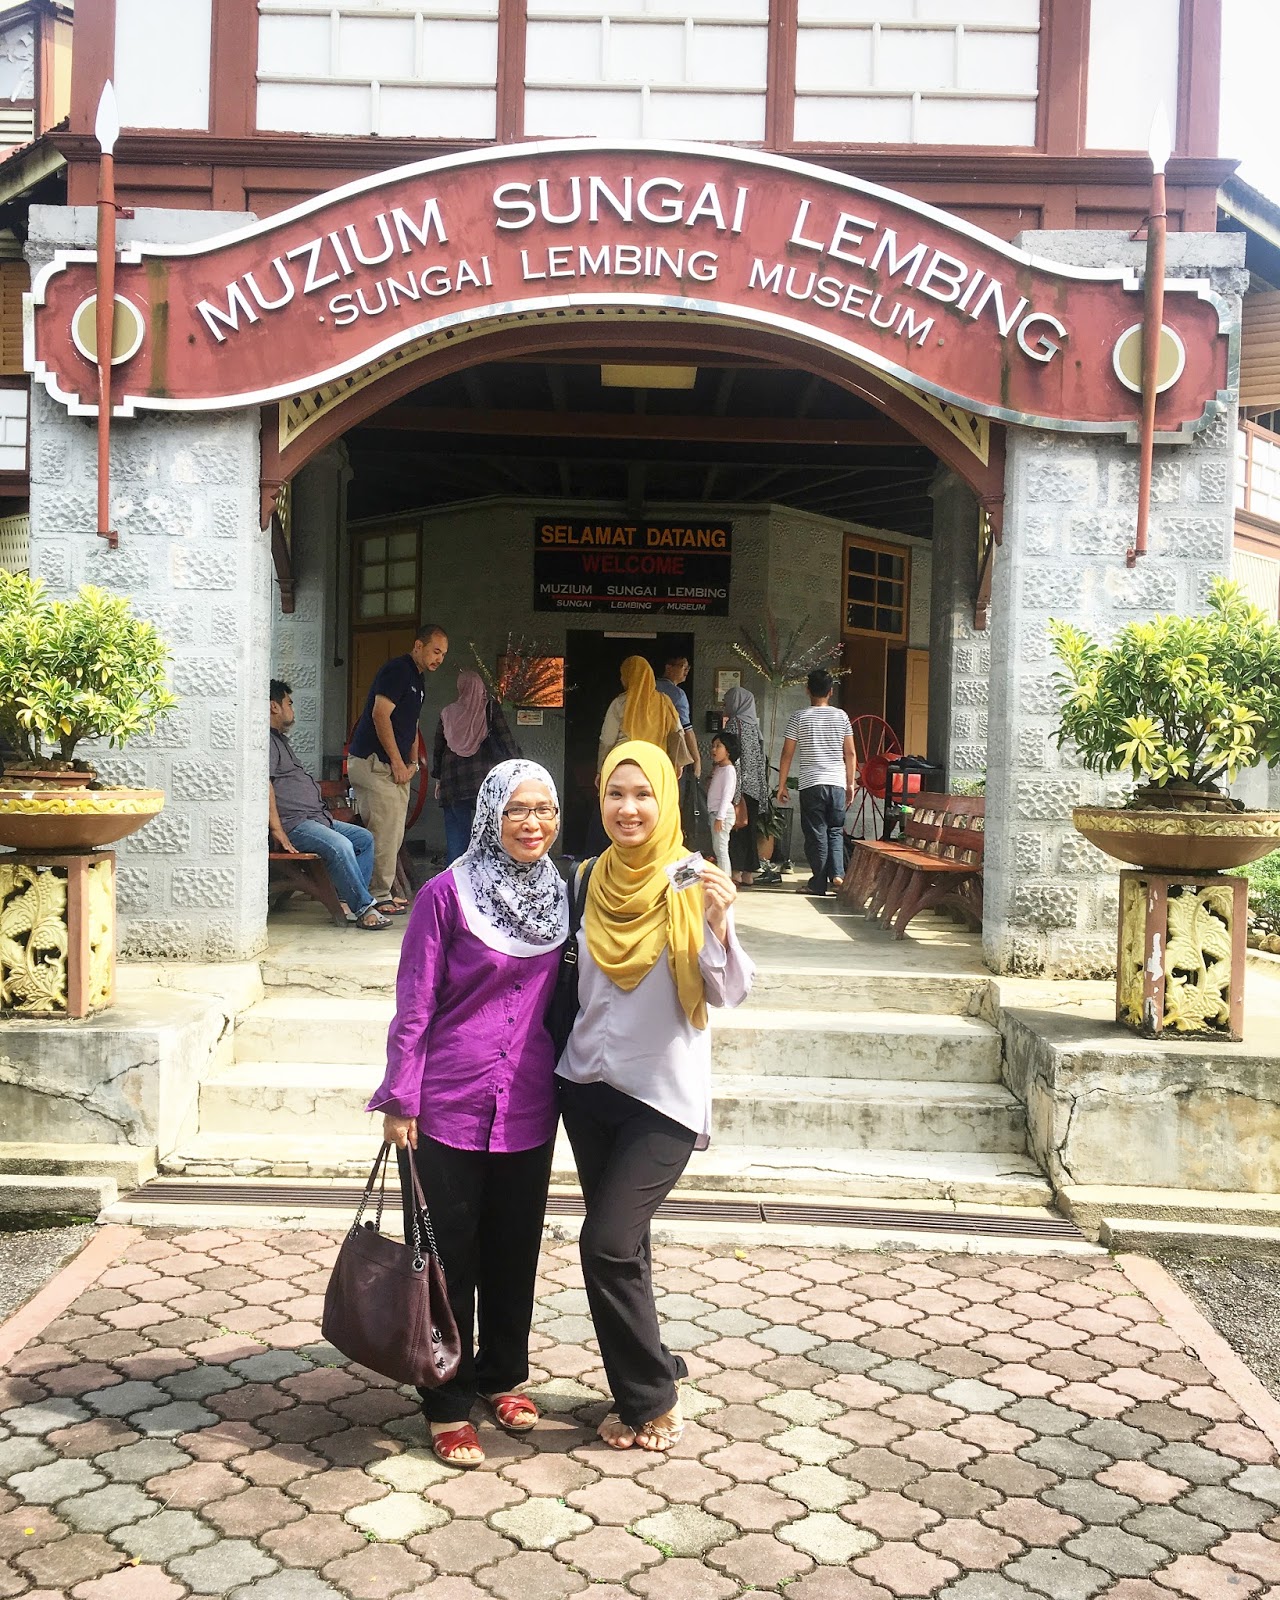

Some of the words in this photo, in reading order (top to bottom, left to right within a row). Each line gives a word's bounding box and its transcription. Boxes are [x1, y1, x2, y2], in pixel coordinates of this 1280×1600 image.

[195, 197, 449, 345] MUZIUM
[492, 175, 751, 233] SUNGAI
[788, 198, 1069, 363] LEMBING
[328, 255, 493, 326] SUNGAI
[519, 243, 719, 281] LEMBING
[747, 257, 936, 346] MUSEUM
[541, 525, 637, 546] SELAMAT
[646, 528, 726, 548] DATANG
[581, 555, 685, 576] WELCOME
[539, 583, 593, 595] MUZIUM
[606, 585, 657, 596] SUNGAI
[667, 587, 727, 599] LEMBING
[556, 599, 592, 608] SUNGAI
[610, 601, 652, 610] LEMBING
[666, 602, 706, 611] MUSEUM
